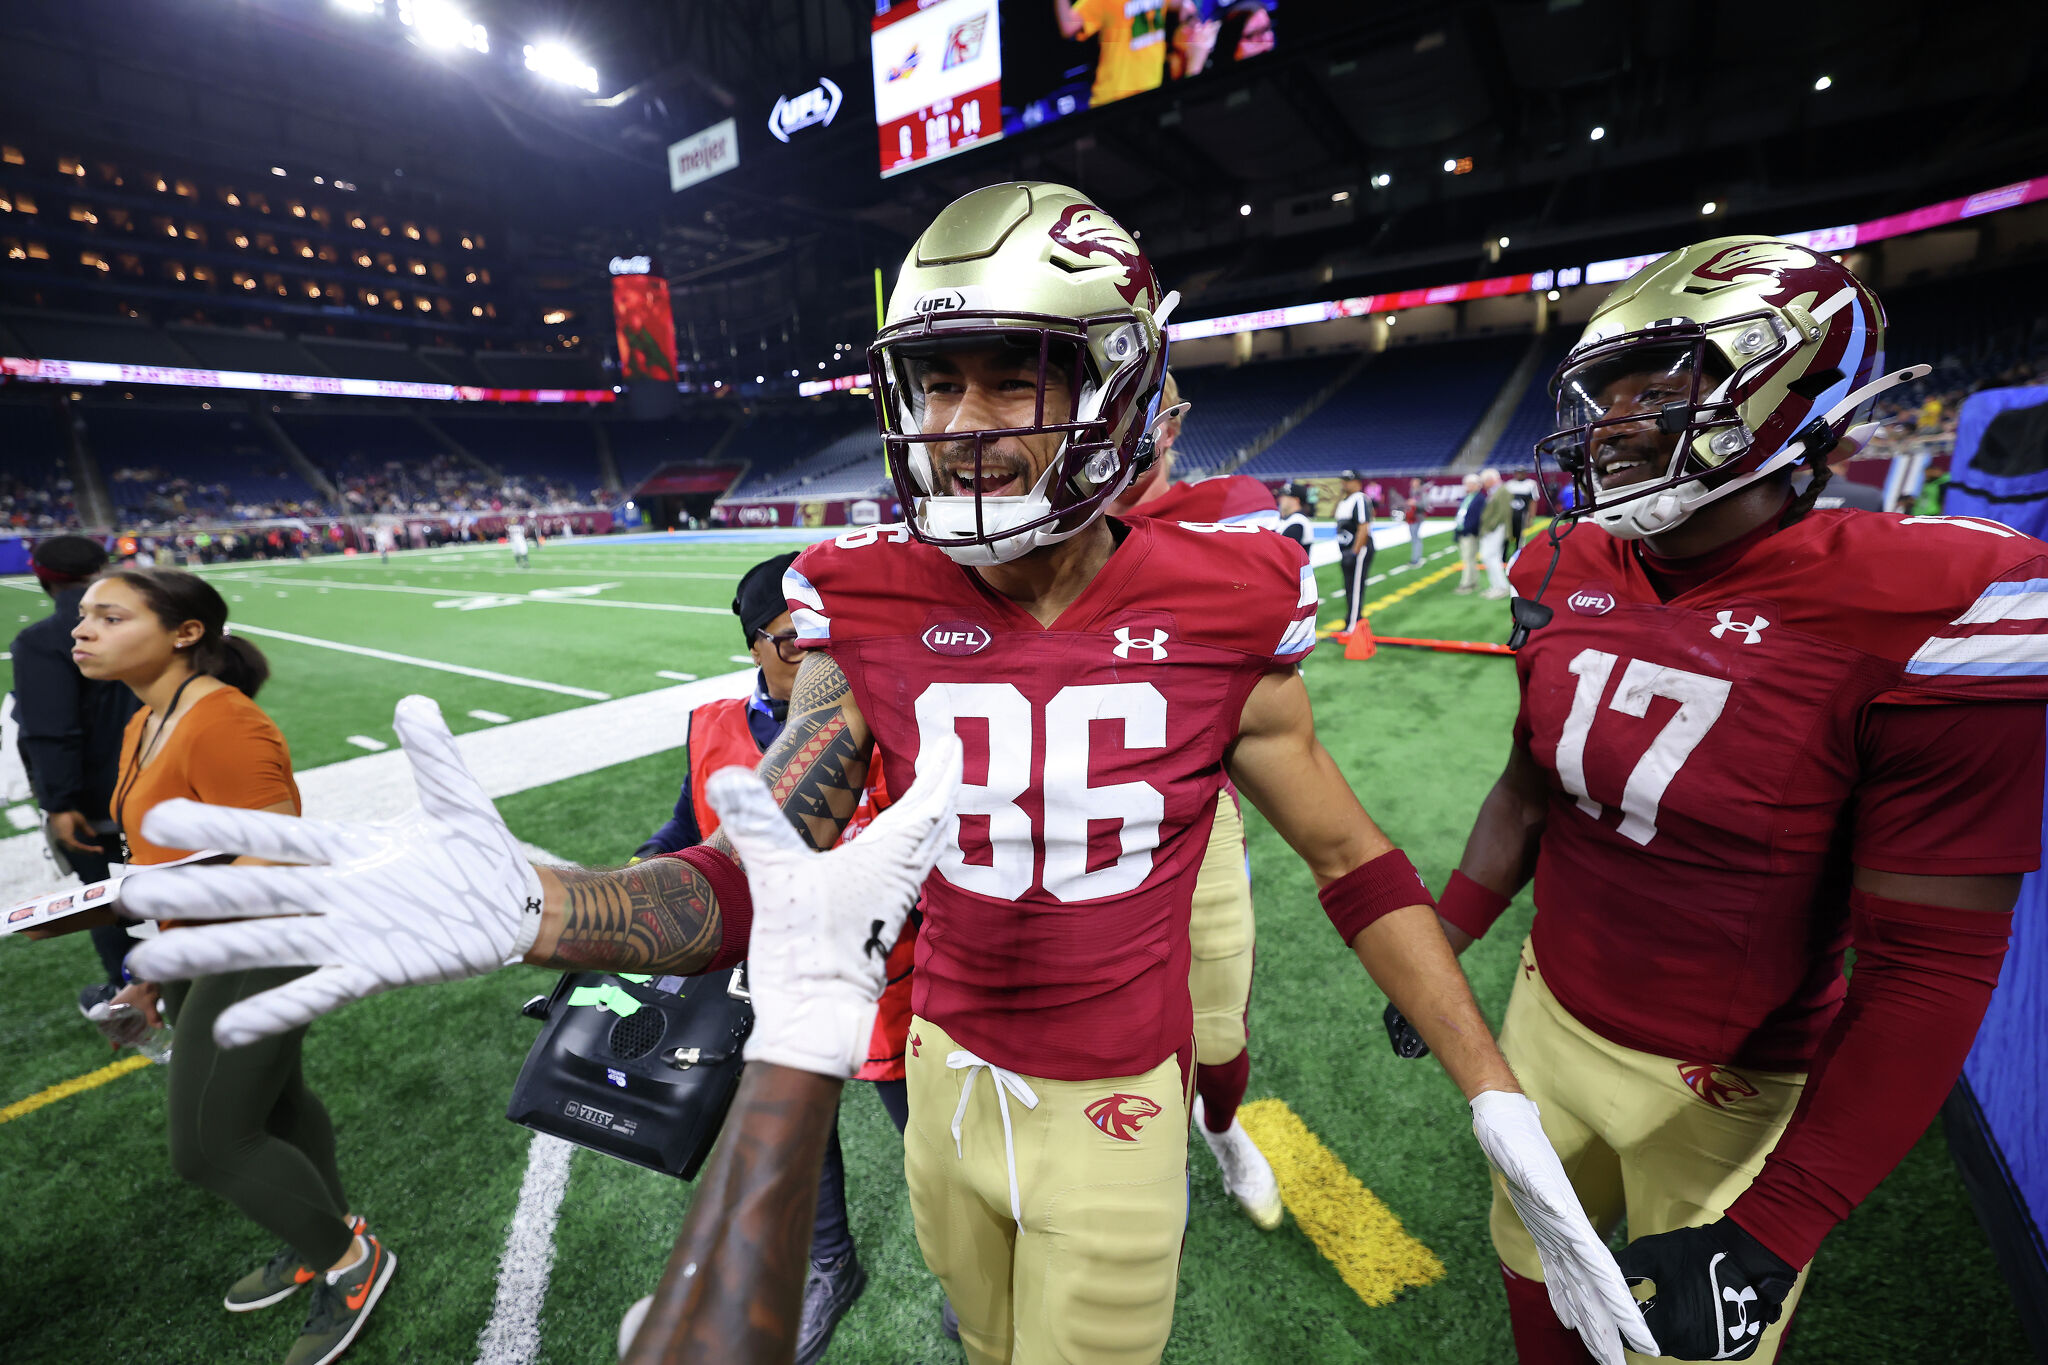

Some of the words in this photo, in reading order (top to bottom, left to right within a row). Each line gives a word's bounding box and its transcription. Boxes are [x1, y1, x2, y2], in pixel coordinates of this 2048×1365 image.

[678, 136, 727, 176] meijer
[914, 681, 1168, 903] 86
[1556, 648, 1732, 847] 17
[579, 1107, 613, 1126] ASTRA
